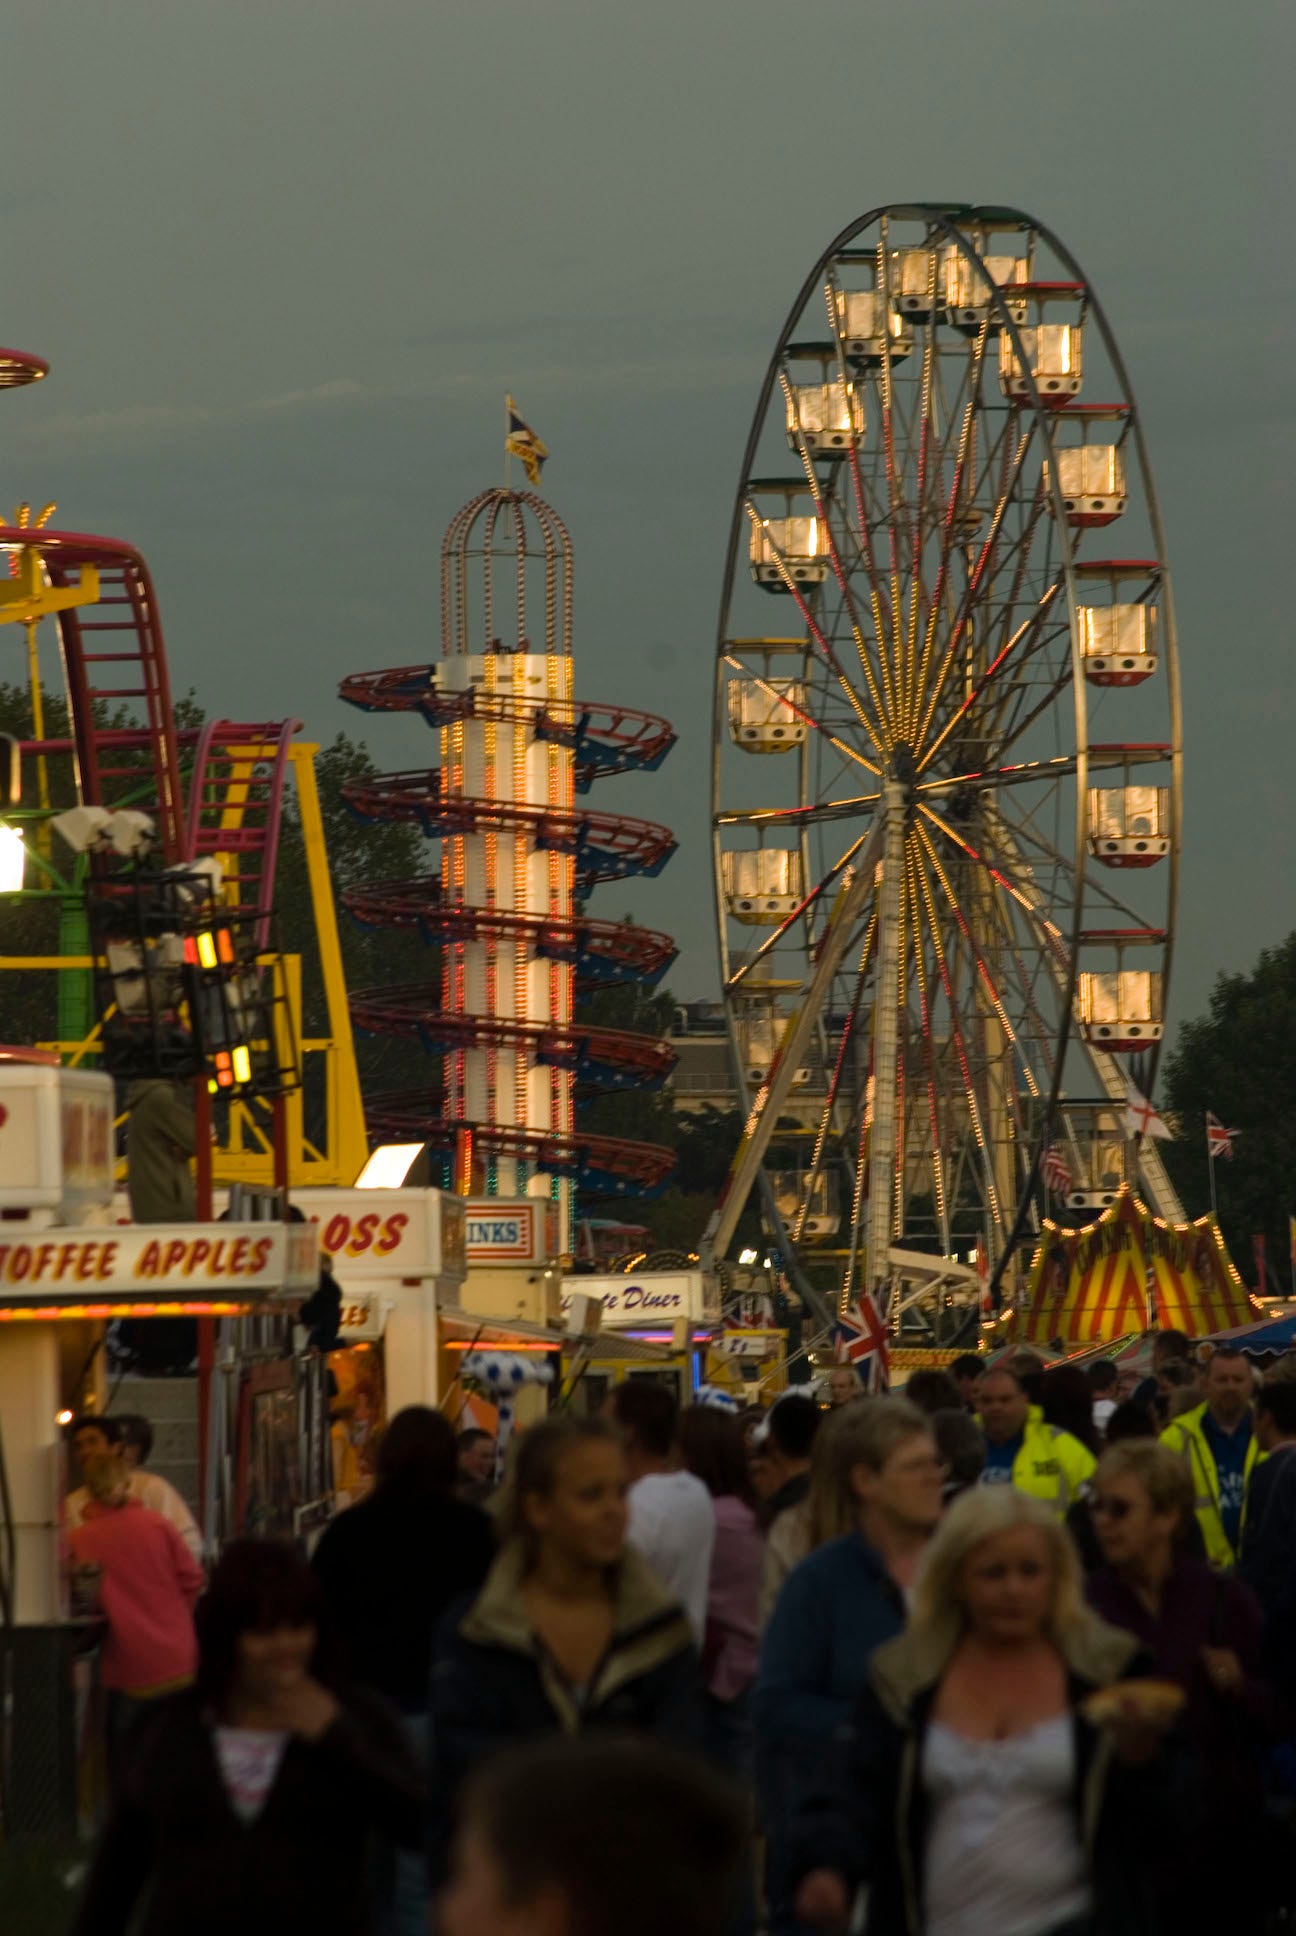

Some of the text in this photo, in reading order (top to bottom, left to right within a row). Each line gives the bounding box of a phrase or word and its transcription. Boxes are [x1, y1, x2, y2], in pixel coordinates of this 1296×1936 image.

[312, 1213, 410, 1257] OSS
[133, 1236, 274, 1278] APPLES
[621, 1286, 682, 1310] Diner
